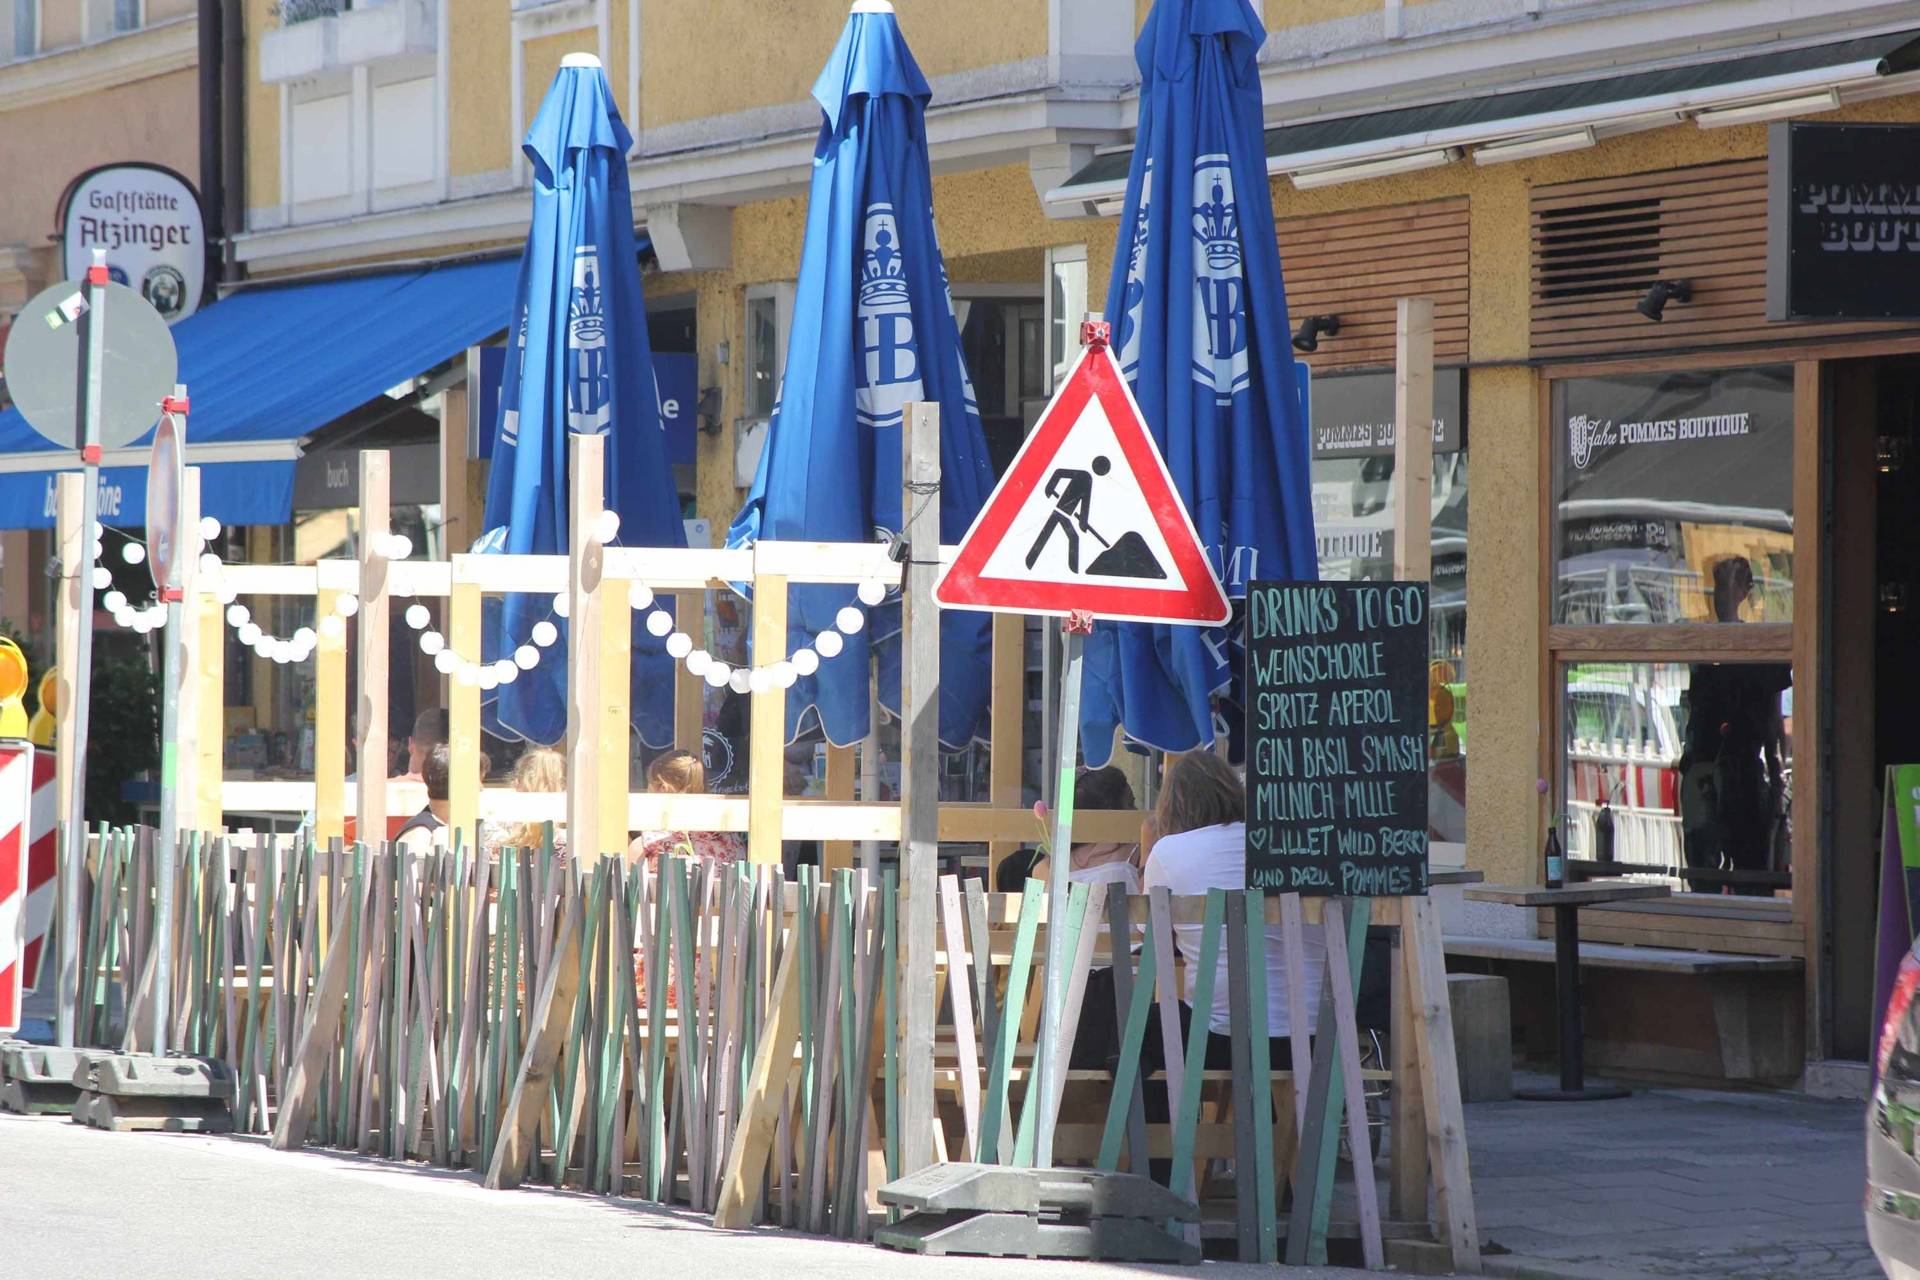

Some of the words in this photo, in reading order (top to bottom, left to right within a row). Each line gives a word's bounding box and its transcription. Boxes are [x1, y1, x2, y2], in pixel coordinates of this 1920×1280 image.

[80, 216, 191, 251] Atzinger
[1316, 423, 1372, 450] POMMES
[1619, 420, 1676, 445] POMMES
[1678, 412, 1749, 439] BOUTIQUE
[96, 475, 122, 516] öne
[1316, 527, 1383, 558] UTIQUE
[1252, 587, 1338, 639] DRINKS
[1346, 587, 1382, 631] TO
[1385, 586, 1423, 627] GO
[1253, 642, 1386, 686] WEINSCHORLE
[1257, 692, 1319, 730] SPRITZ
[1328, 689, 1400, 726] APEROL
[1256, 737, 1294, 776] GIN
[1302, 737, 1357, 778] BASIL
[1361, 735, 1425, 773] SMASH
[1256, 781, 1335, 821] MUNICH
[1344, 780, 1400, 818] MULE
[1268, 825, 1334, 856] LILLET
[1337, 828, 1376, 855] WILD
[1379, 826, 1428, 857] BERRY
